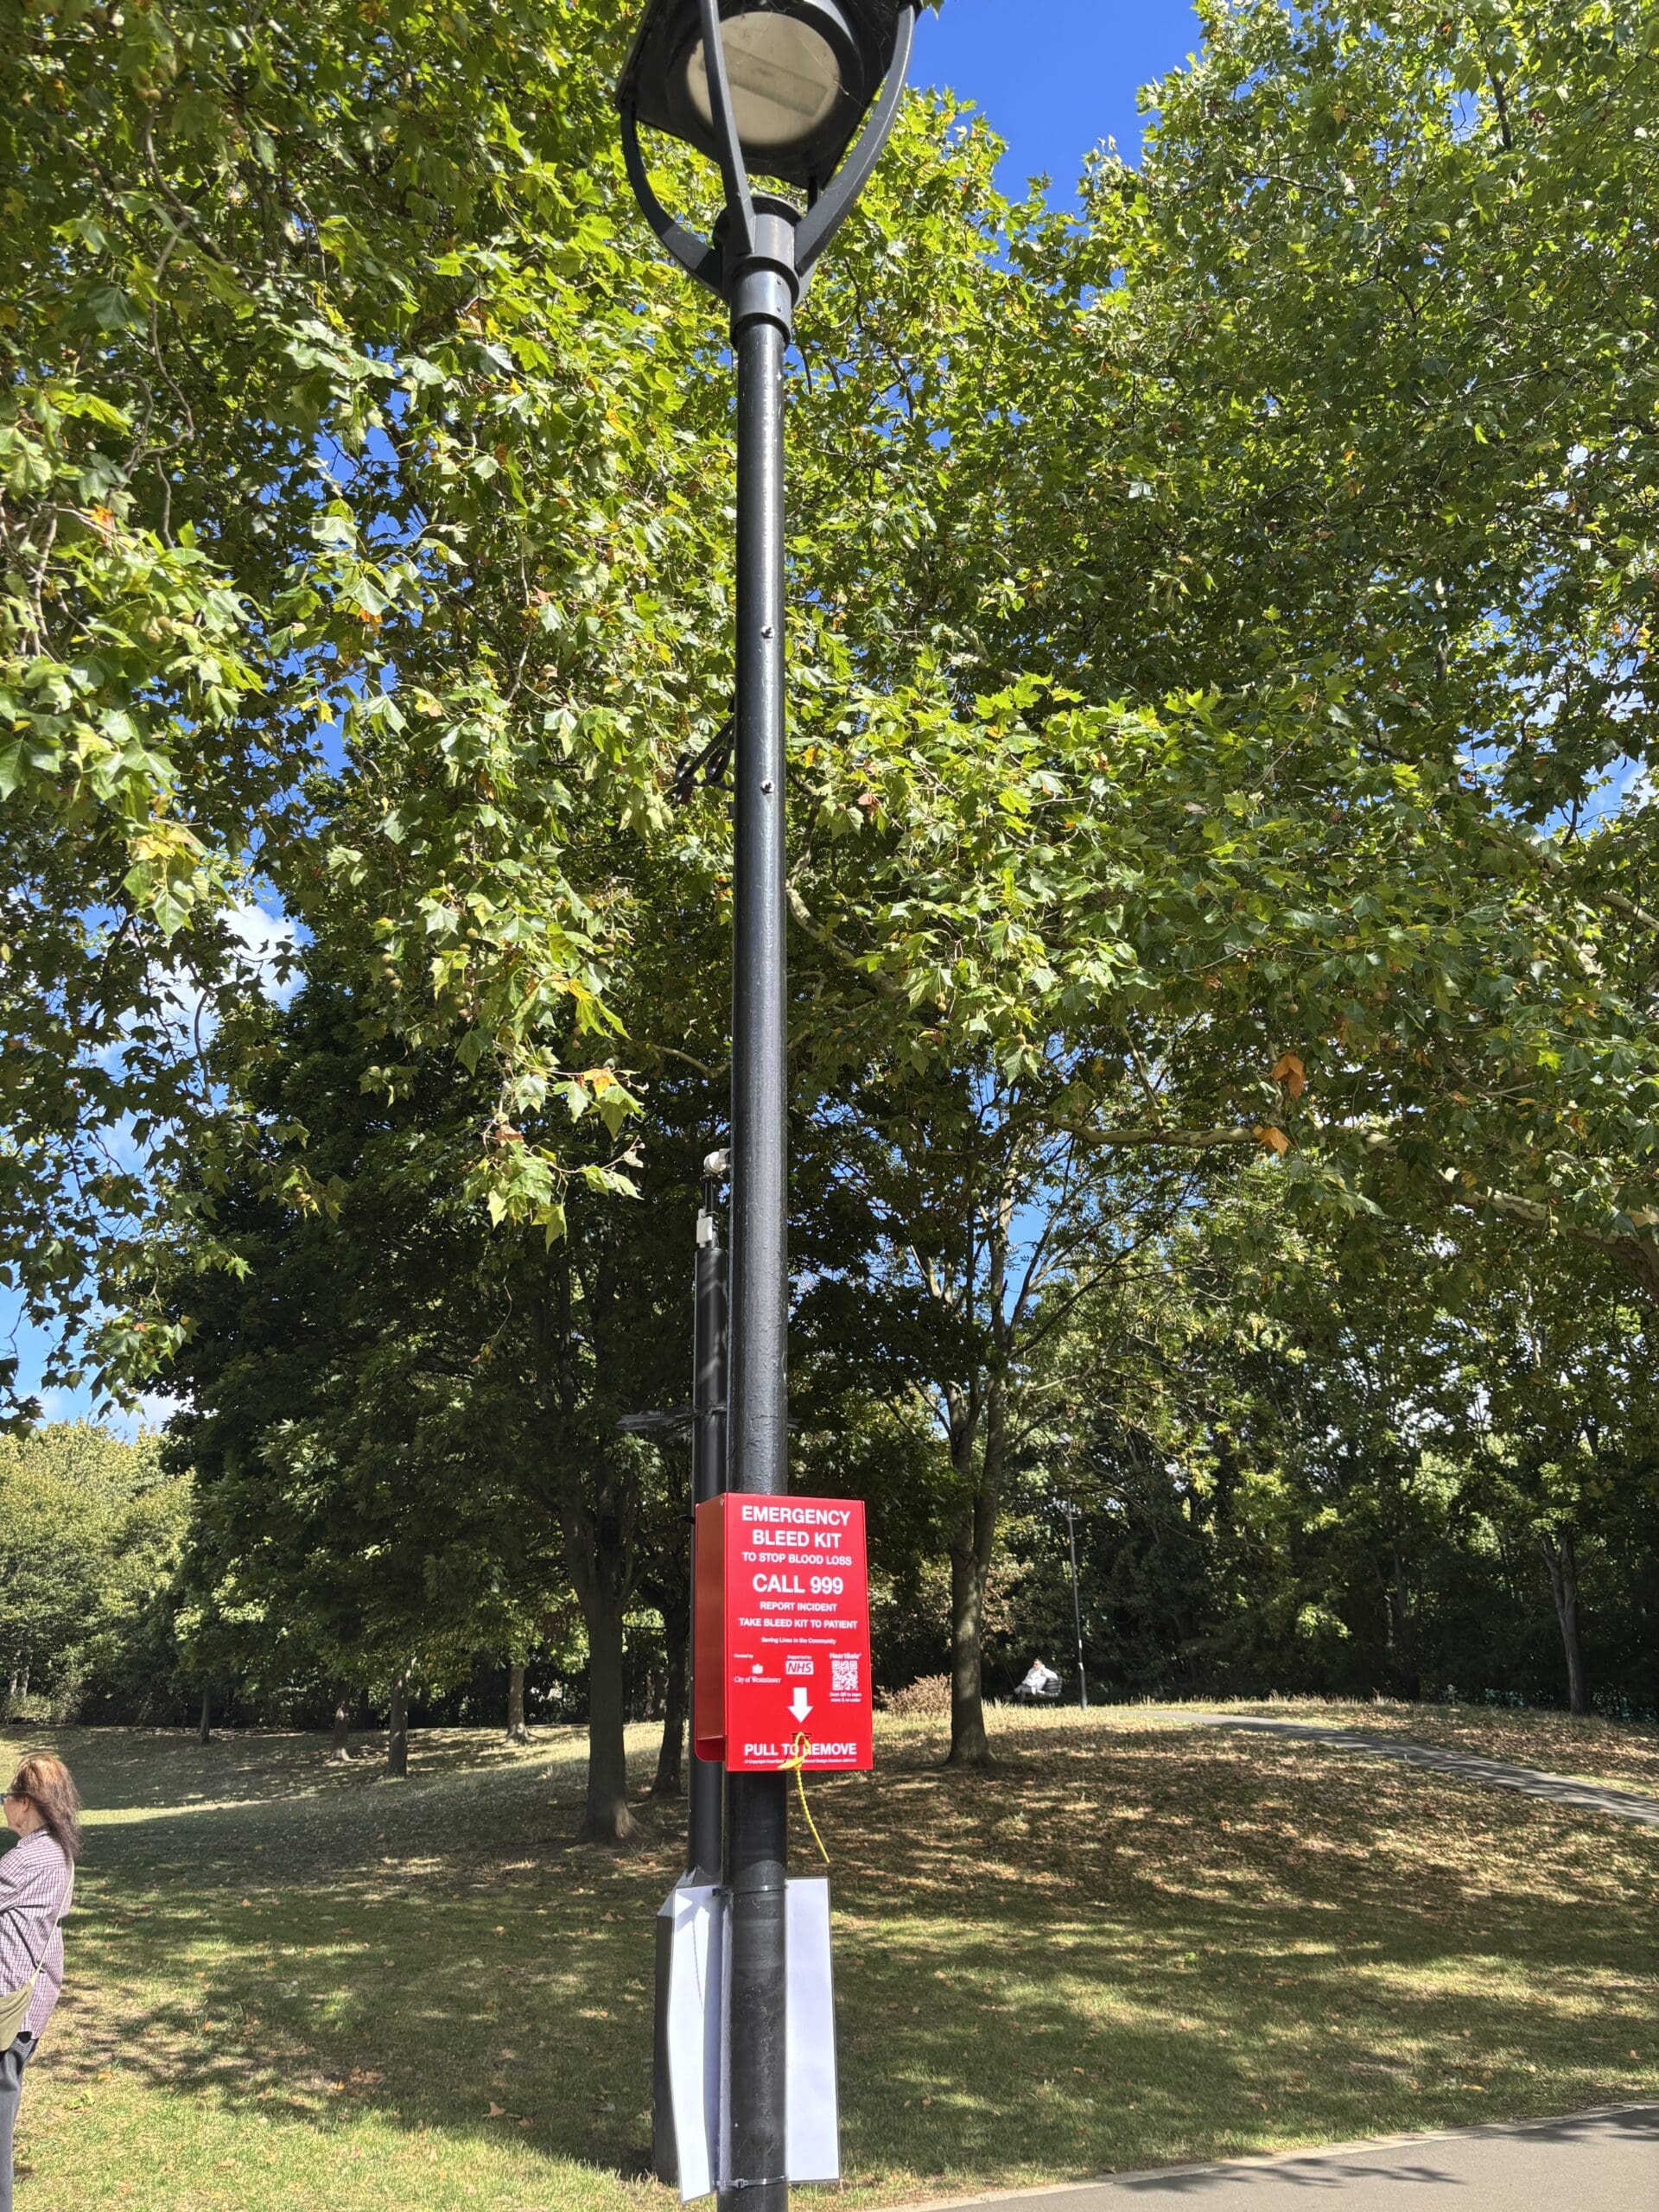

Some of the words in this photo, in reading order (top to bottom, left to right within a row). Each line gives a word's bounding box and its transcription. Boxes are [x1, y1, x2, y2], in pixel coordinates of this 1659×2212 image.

[741, 1505, 851, 1526] EMERGENCY
[753, 1529, 810, 1547] BLEED
[814, 1532, 842, 1548] KIT
[742, 1552, 757, 1562] TO
[759, 1553, 785, 1563] STOP
[788, 1554, 823, 1565] BLOOD
[826, 1555, 853, 1566] LOSS
[753, 1573, 805, 1593] CALL
[810, 1576, 844, 1595] 999
[760, 1601, 795, 1611] REPORT
[797, 1603, 837, 1612] INCIDENT
[739, 1618, 761, 1626] TAKE
[763, 1618, 792, 1628] BLEED
[794, 1619, 809, 1628] KIT
[810, 1619, 822, 1628] TO
[823, 1620, 858, 1630] PATIENT
[787, 1662, 812, 1674] NHS
[734, 1675, 745, 1684] City
[744, 1743, 778, 1757] PULL
